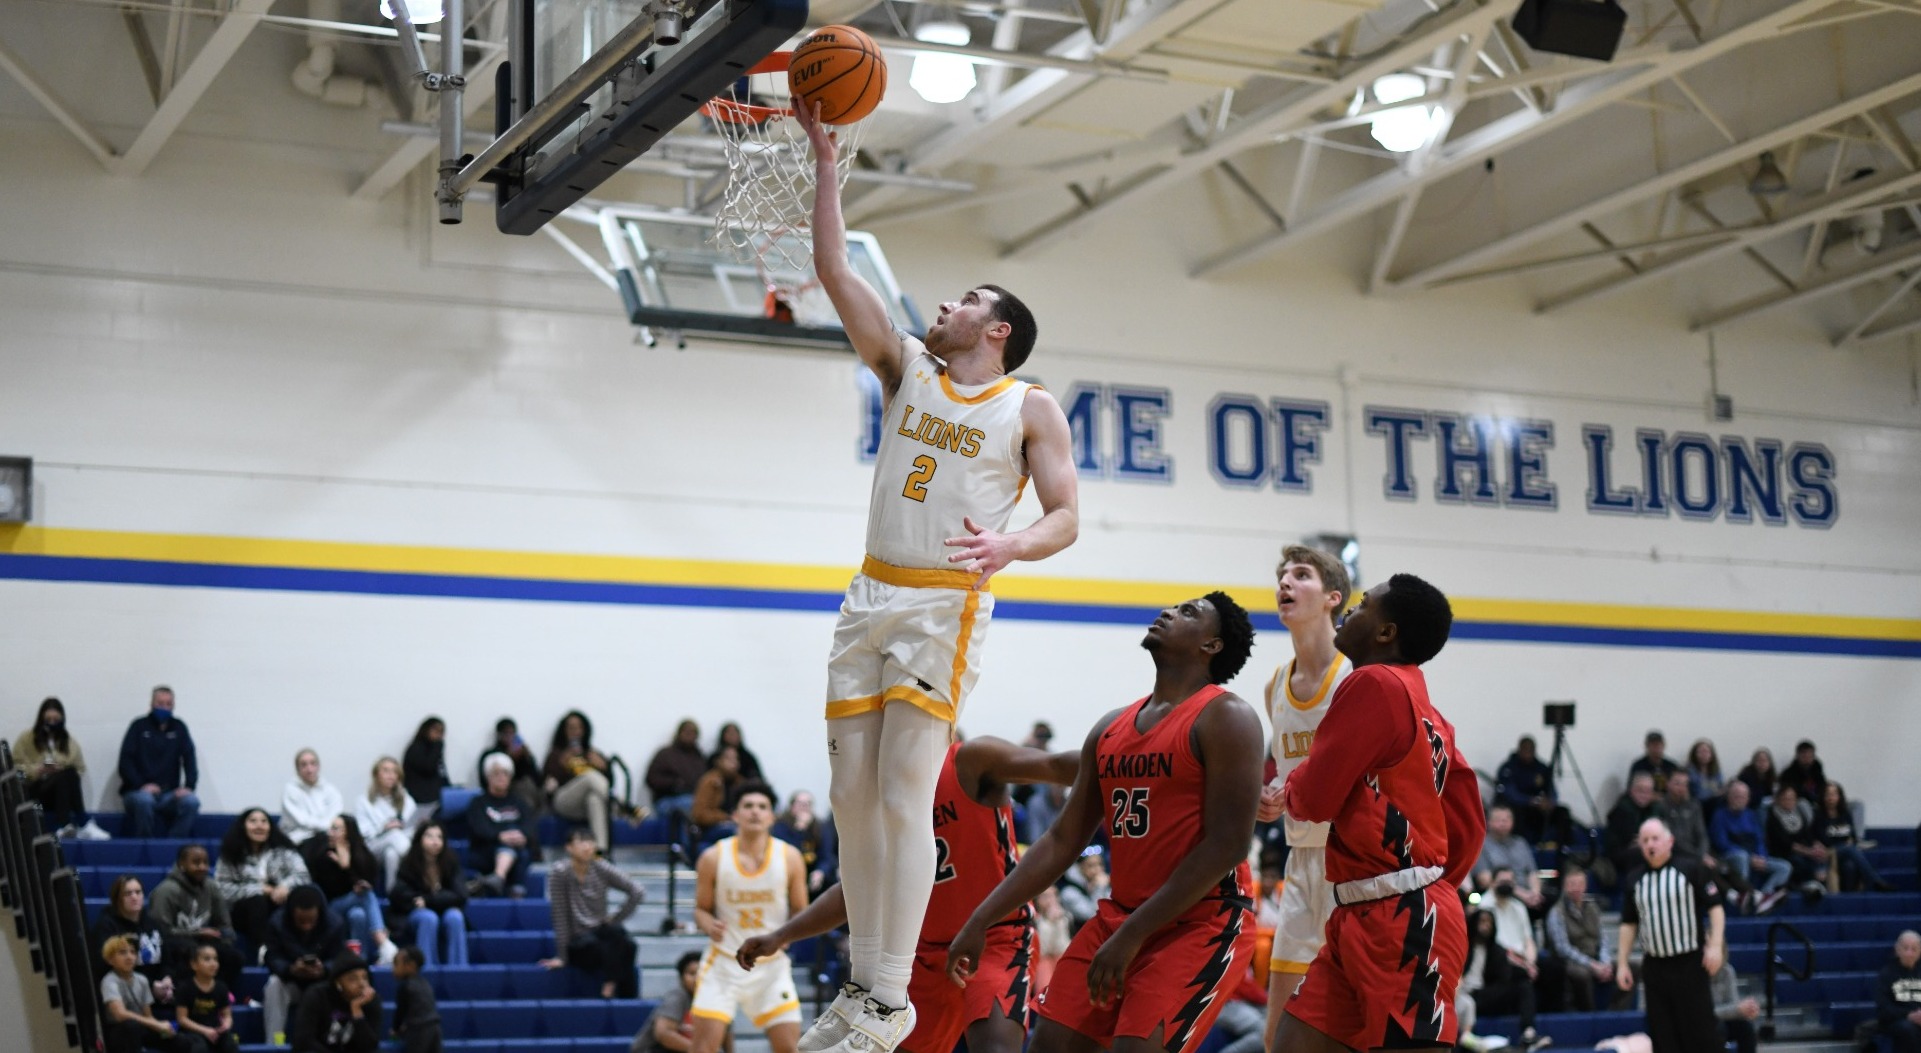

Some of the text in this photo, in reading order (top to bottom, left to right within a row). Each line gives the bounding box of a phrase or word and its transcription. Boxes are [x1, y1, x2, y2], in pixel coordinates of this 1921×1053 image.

[794, 60, 823, 87] EVO
[898, 405, 986, 459] LIONS
[902, 454, 938, 503] 2
[1206, 391, 1330, 495] OF
[1364, 404, 1558, 510] THE
[1582, 422, 1838, 529] LIONS
[1282, 729, 1317, 759] LIO
[1112, 787, 1150, 838] 25
